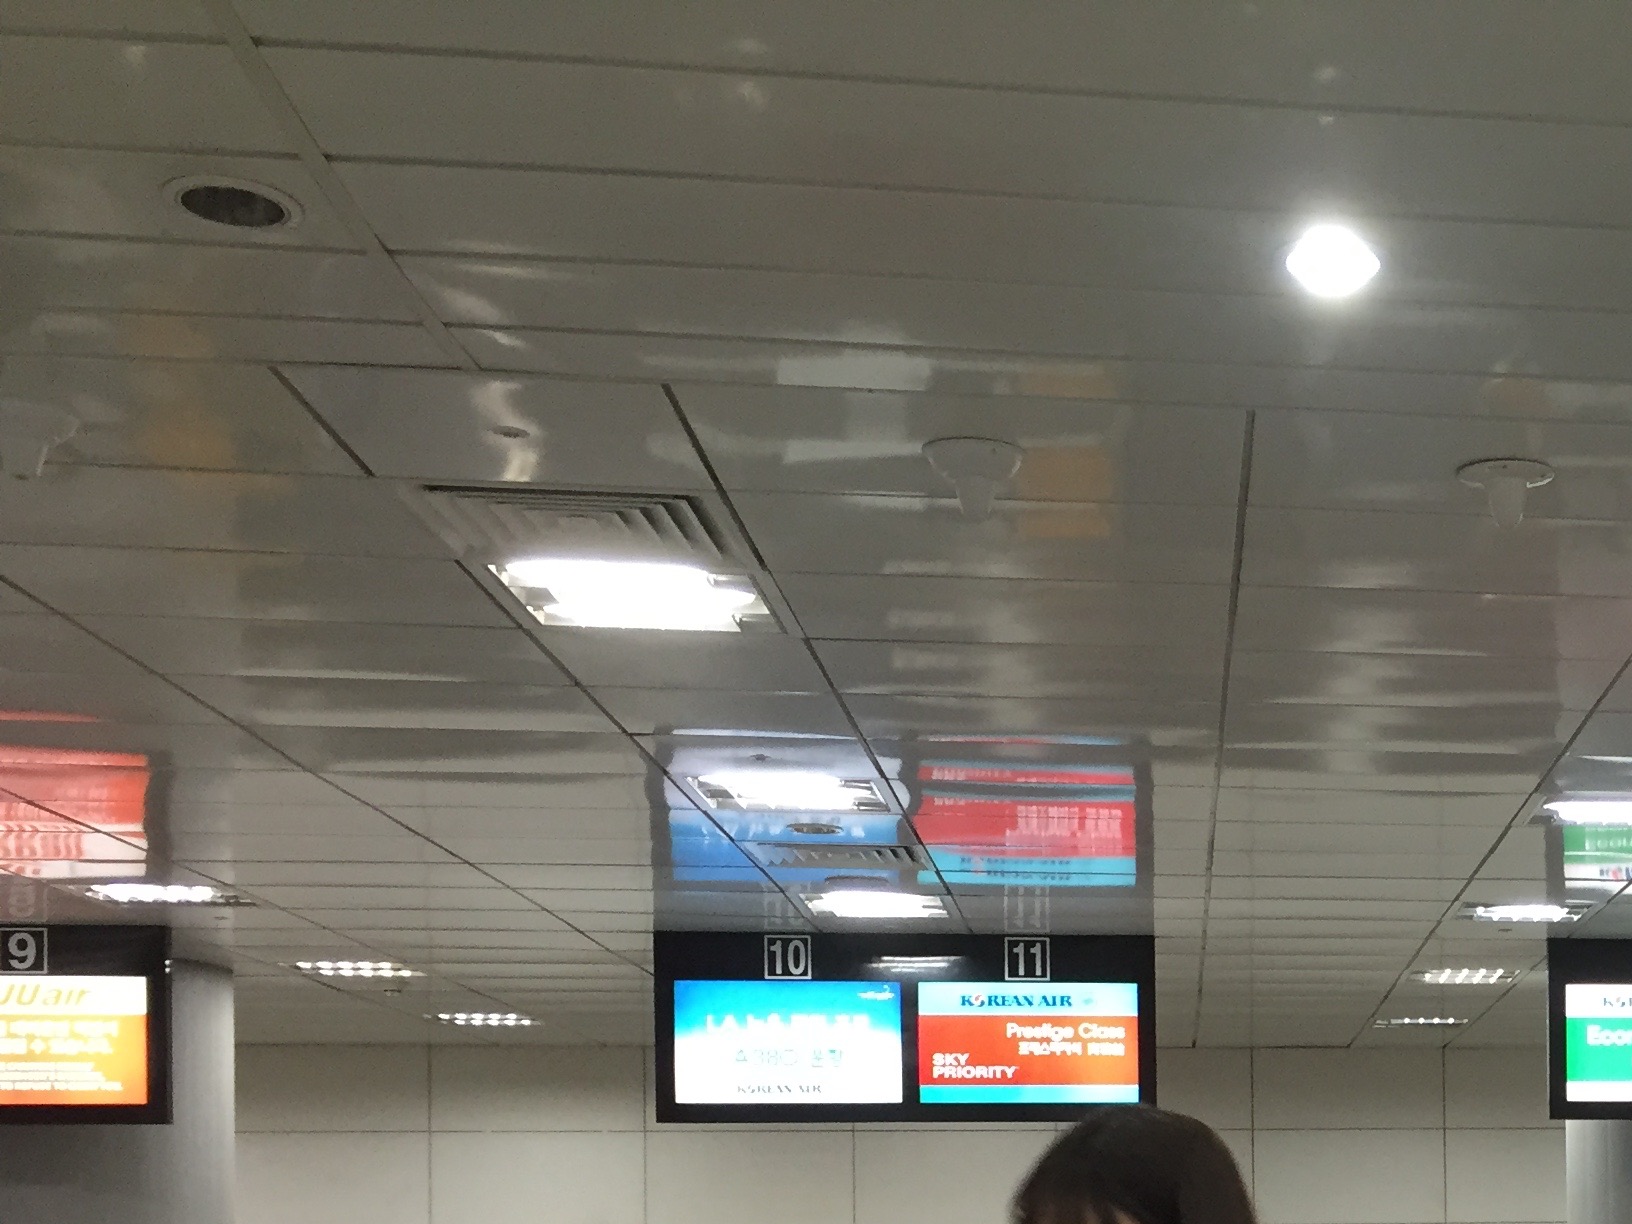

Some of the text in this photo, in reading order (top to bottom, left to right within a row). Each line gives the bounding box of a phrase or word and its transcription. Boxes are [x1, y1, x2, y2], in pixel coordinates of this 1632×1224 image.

[8, 932, 37, 970] 9
[769, 939, 806, 976] 10
[1012, 942, 1043, 976] 11
[960, 994, 1073, 1008] KOREAN AIR
[1006, 1022, 1126, 1042] Prestige Class
[932, 1052, 970, 1066] SKY
[932, 1065, 1016, 1079] PRIORITY
